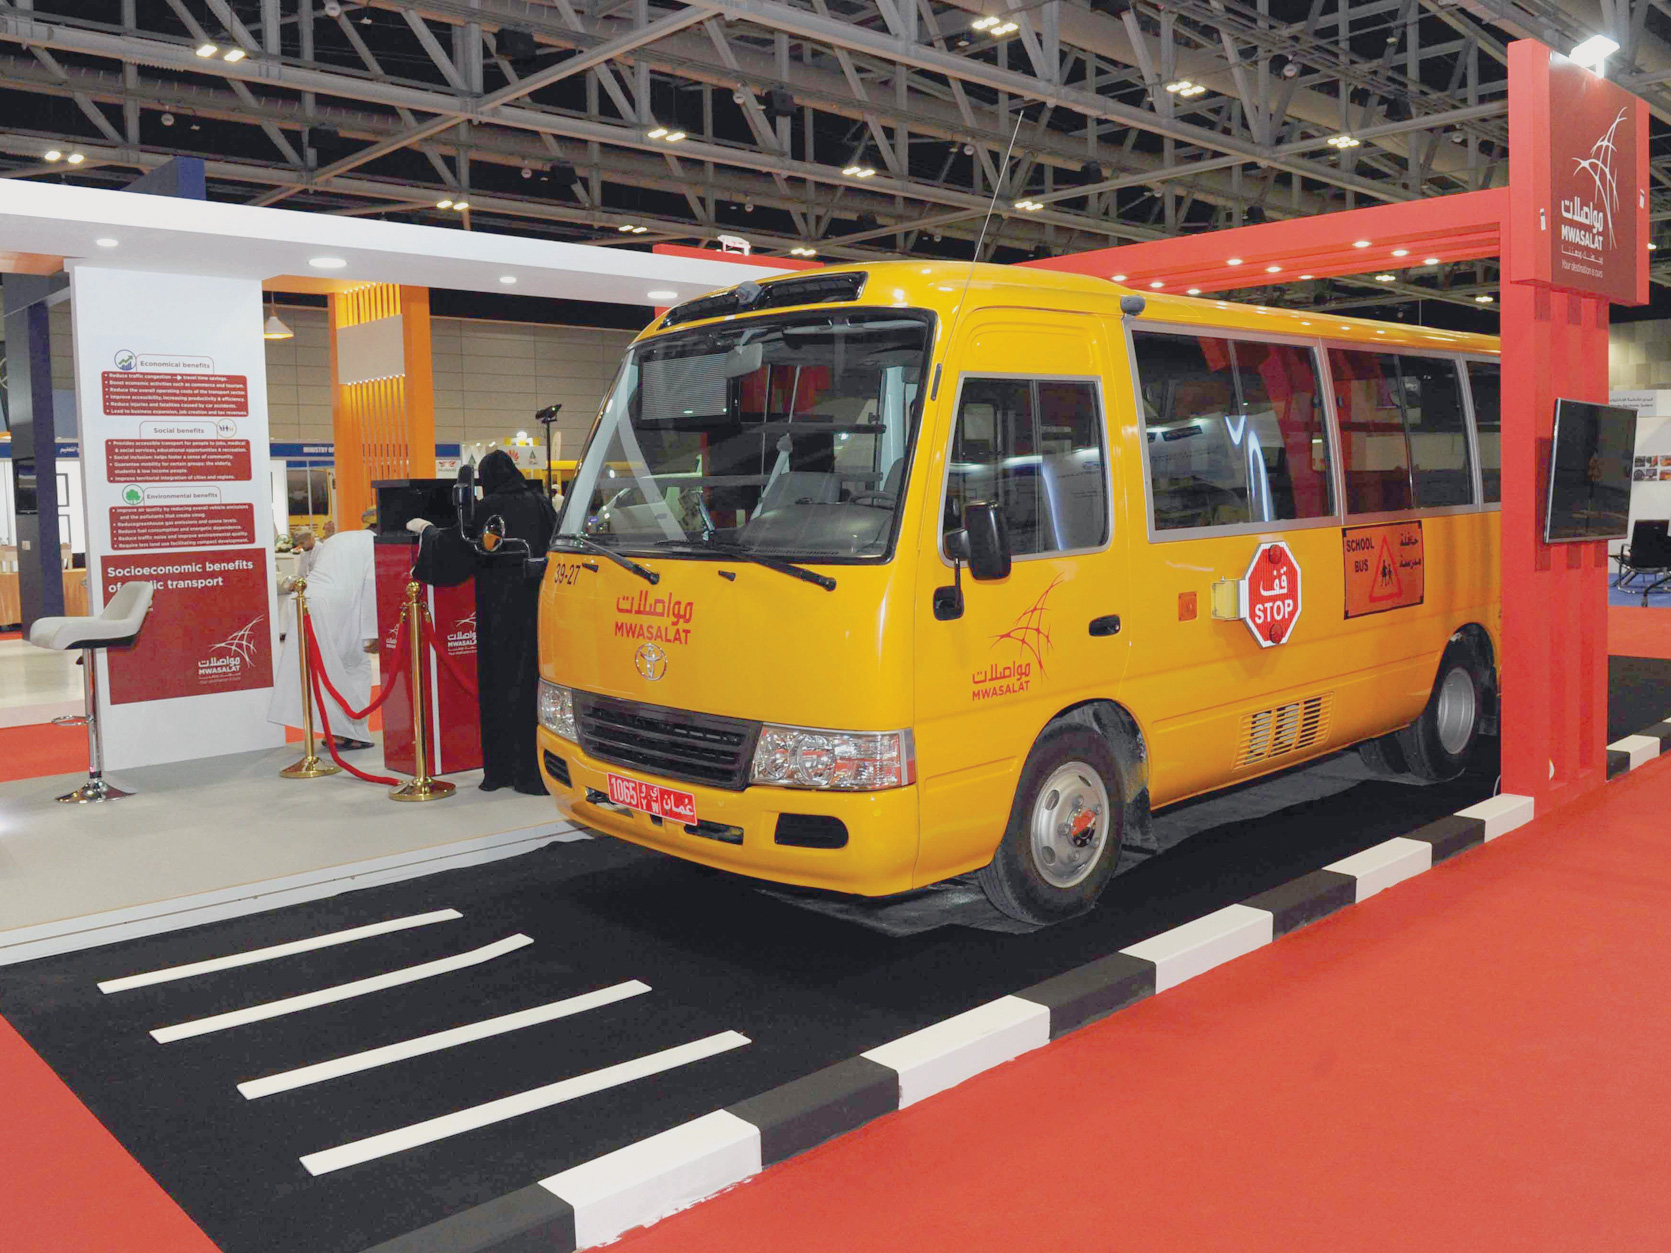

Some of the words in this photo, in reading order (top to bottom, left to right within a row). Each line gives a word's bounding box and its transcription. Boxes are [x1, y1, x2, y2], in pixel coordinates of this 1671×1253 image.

[1562, 196, 1603, 233] مواصلات
[1562, 225, 1603, 251] MWASALAT
[1346, 538, 1374, 552] SCHOOL
[108, 563, 202, 577] Socioeconomic
[206, 560, 253, 572] benefits
[554, 563, 580, 585] 39-27
[1355, 559, 1368, 572] BUS
[108, 582, 122, 593] of
[168, 577, 223, 590] transport
[1260, 566, 1287, 596] قف
[616, 590, 694, 626] مواصلات
[1255, 600, 1293, 624] STOP
[447, 631, 477, 640] واصلات
[615, 622, 691, 645] MWASALAT
[198, 656, 240, 667] مواصلات
[199, 666, 240, 675] MWASALAT
[972, 660, 1030, 685] مواصلات
[972, 680, 1030, 701] MWASALAT
[611, 778, 637, 805] 1065
[652, 802, 658, 813] W
